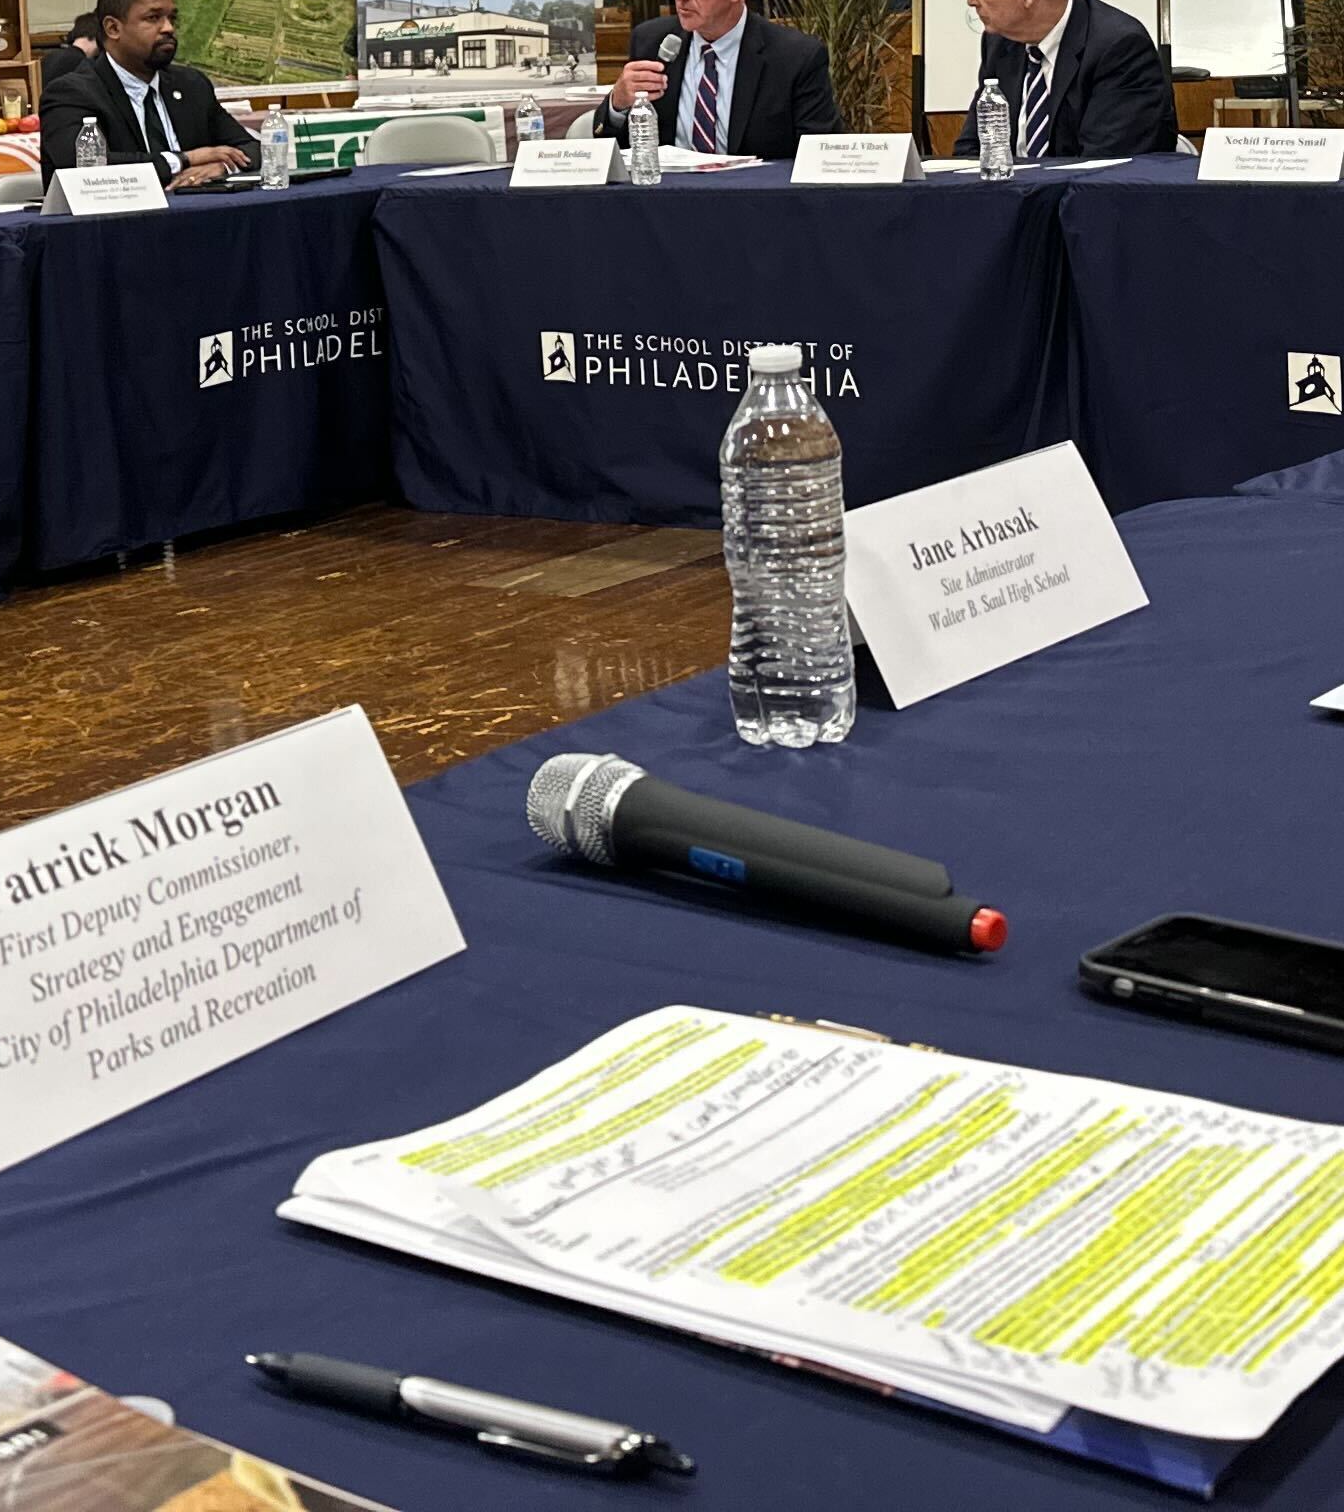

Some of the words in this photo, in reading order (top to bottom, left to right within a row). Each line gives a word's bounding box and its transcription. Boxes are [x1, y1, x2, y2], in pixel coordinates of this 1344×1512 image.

[1224, 135, 1260, 147] Xochitl
[1263, 136, 1296, 147] Torres
[1297, 136, 1327, 147] Small
[240, 321, 274, 343] THE
[284, 312, 339, 336] SCHOOL
[242, 329, 383, 378] PHILADEL
[583, 332, 624, 351] THE
[634, 334, 712, 356] SCHOOL
[829, 343, 855, 361] OF
[908, 537, 957, 571] Jane
[960, 506, 1040, 555] Arbasak
[928, 604, 966, 632] Walter
[967, 598, 983, 620] B.
[980, 589, 1007, 614] Saul
[1007, 582, 1036, 605] High
[1034, 564, 1071, 595] School
[939, 576, 964, 597] Site
[965, 551, 1036, 589] Administrator
[126, 779, 283, 859] Morgan
[62, 888, 142, 940] Deputy
[146, 829, 301, 907] Commissioner,
[29, 943, 128, 1004] Strategy
[131, 925, 175, 964] and
[178, 872, 305, 946] Engagement
[48, 1007, 76, 1050] of
[77, 956, 219, 1039] Philadelphia
[222, 905, 340, 973] Department
[337, 887, 365, 926] of
[87, 1030, 155, 1081] Parks
[158, 1011, 204, 1050] and
[206, 961, 318, 1030] Recreation
